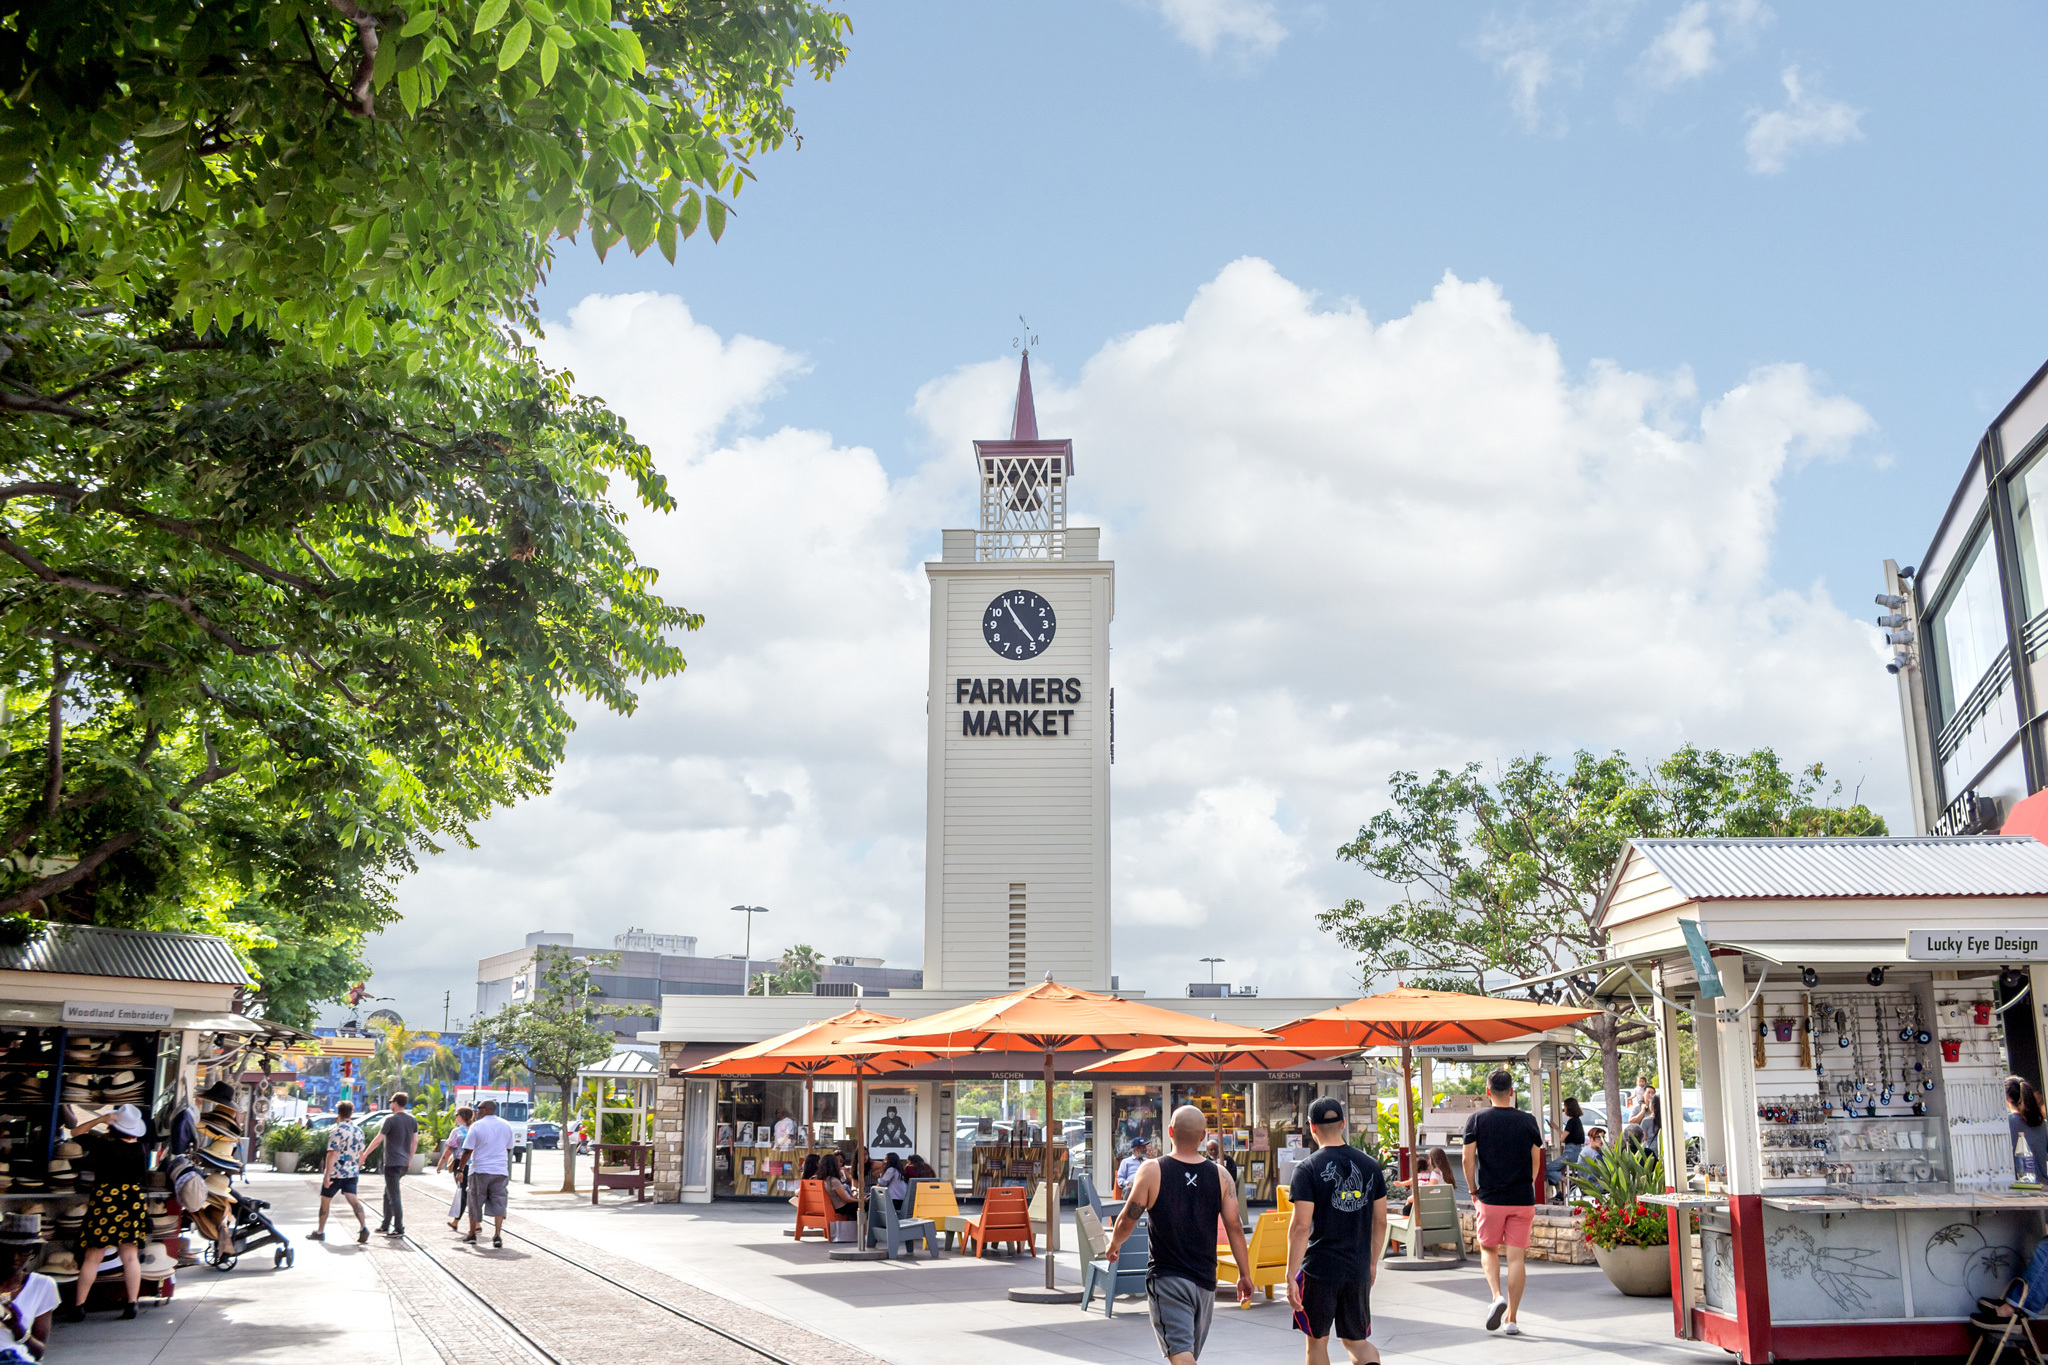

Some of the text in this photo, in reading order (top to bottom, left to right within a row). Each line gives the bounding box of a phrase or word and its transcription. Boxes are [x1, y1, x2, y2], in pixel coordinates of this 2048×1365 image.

[1014, 595, 1025, 604] 12
[1031, 599, 1034, 607] 1
[992, 608, 1002, 617] 10
[1038, 608, 1046, 617] 2
[990, 621, 997, 629] 9
[1042, 620, 1049, 629] 3
[993, 633, 1000, 642] 8
[1038, 633, 1045, 642] 4
[1003, 642, 1010, 651] 7
[1015, 645, 1022, 654] 6
[1029, 642, 1036, 651] 5
[956, 677, 1082, 704] FARMERS
[962, 709, 1075, 736] MARKET
[1951, 790, 1972, 836] LEAF
[1927, 936, 2038, 954] Lucky Eye Design
[68, 1007, 169, 1022] Woodland Embroidery
[1417, 1045, 1440, 1053] Sincerely
